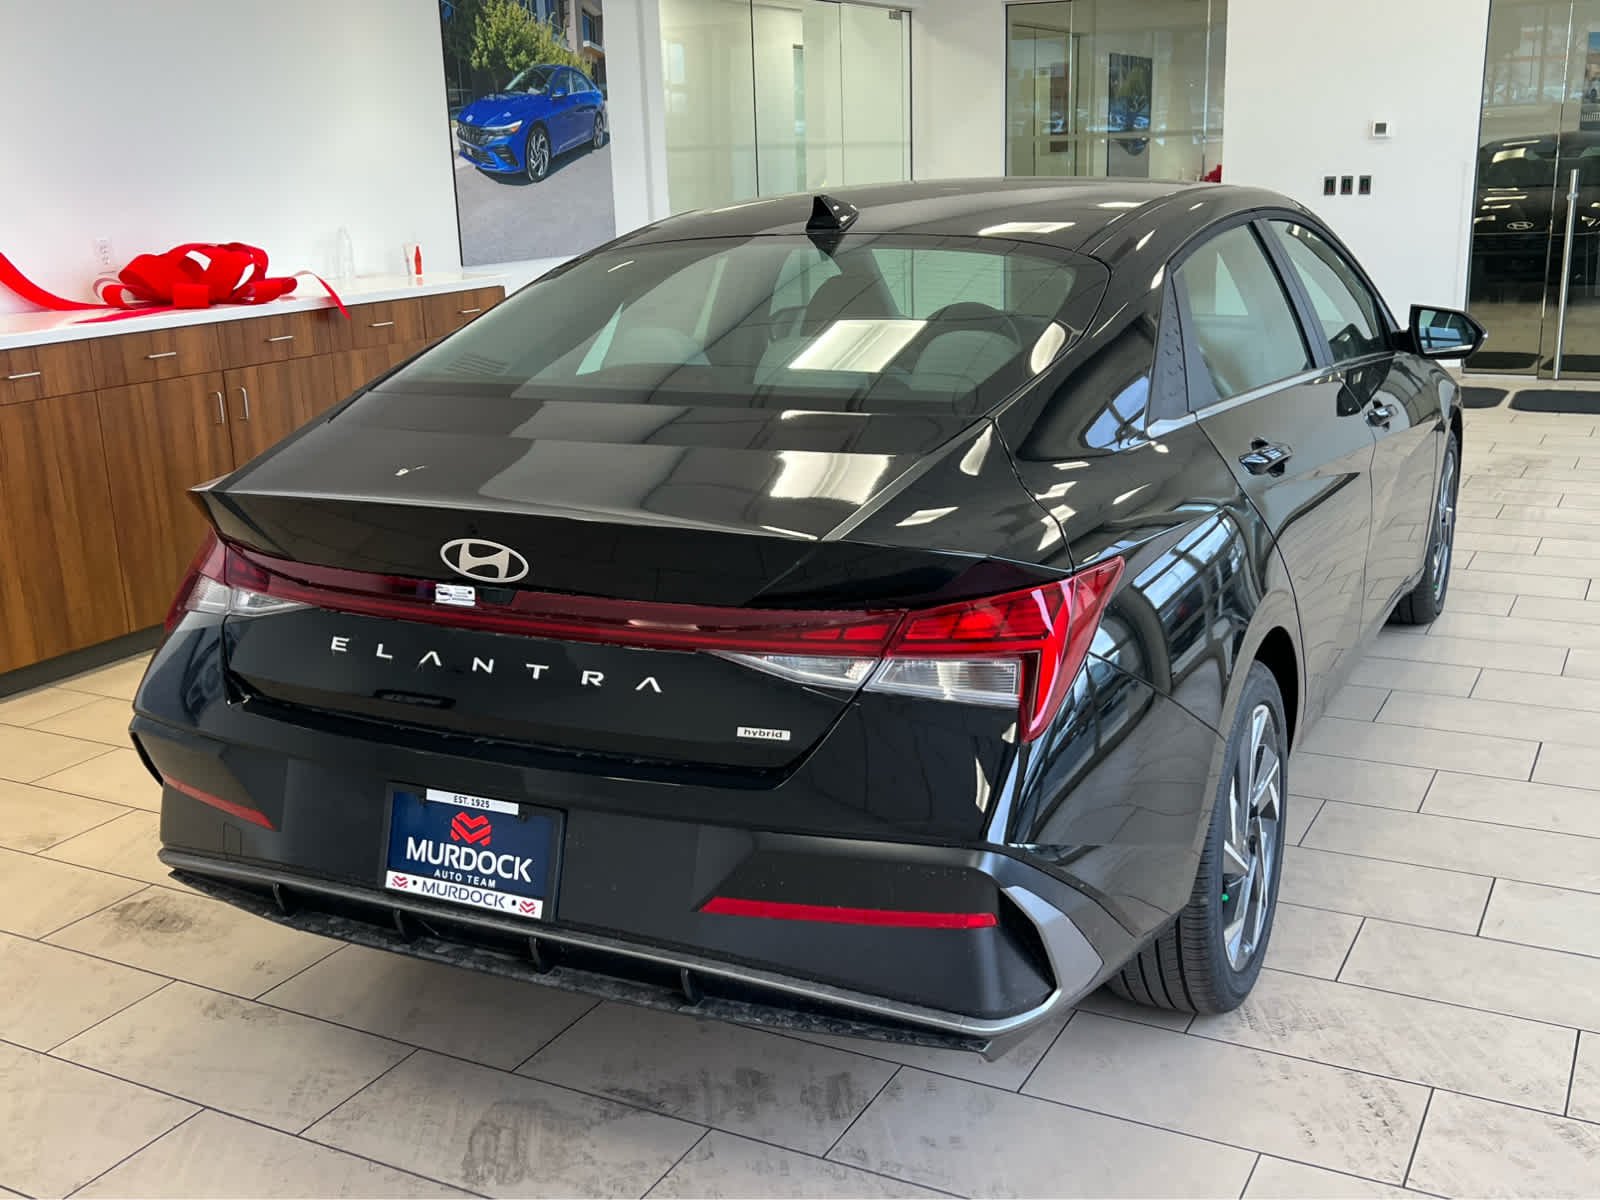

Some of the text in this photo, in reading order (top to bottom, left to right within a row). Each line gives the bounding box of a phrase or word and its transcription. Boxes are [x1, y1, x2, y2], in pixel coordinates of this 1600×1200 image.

[331, 636, 662, 693] ELANTRA
[743, 728, 783, 738] hybrid
[453, 795, 490, 808] EST. 1925
[406, 836, 533, 883] MURDOCK
[434, 869, 496, 888] AUTO TEAM
[421, 879, 507, 909] MURDOCK
